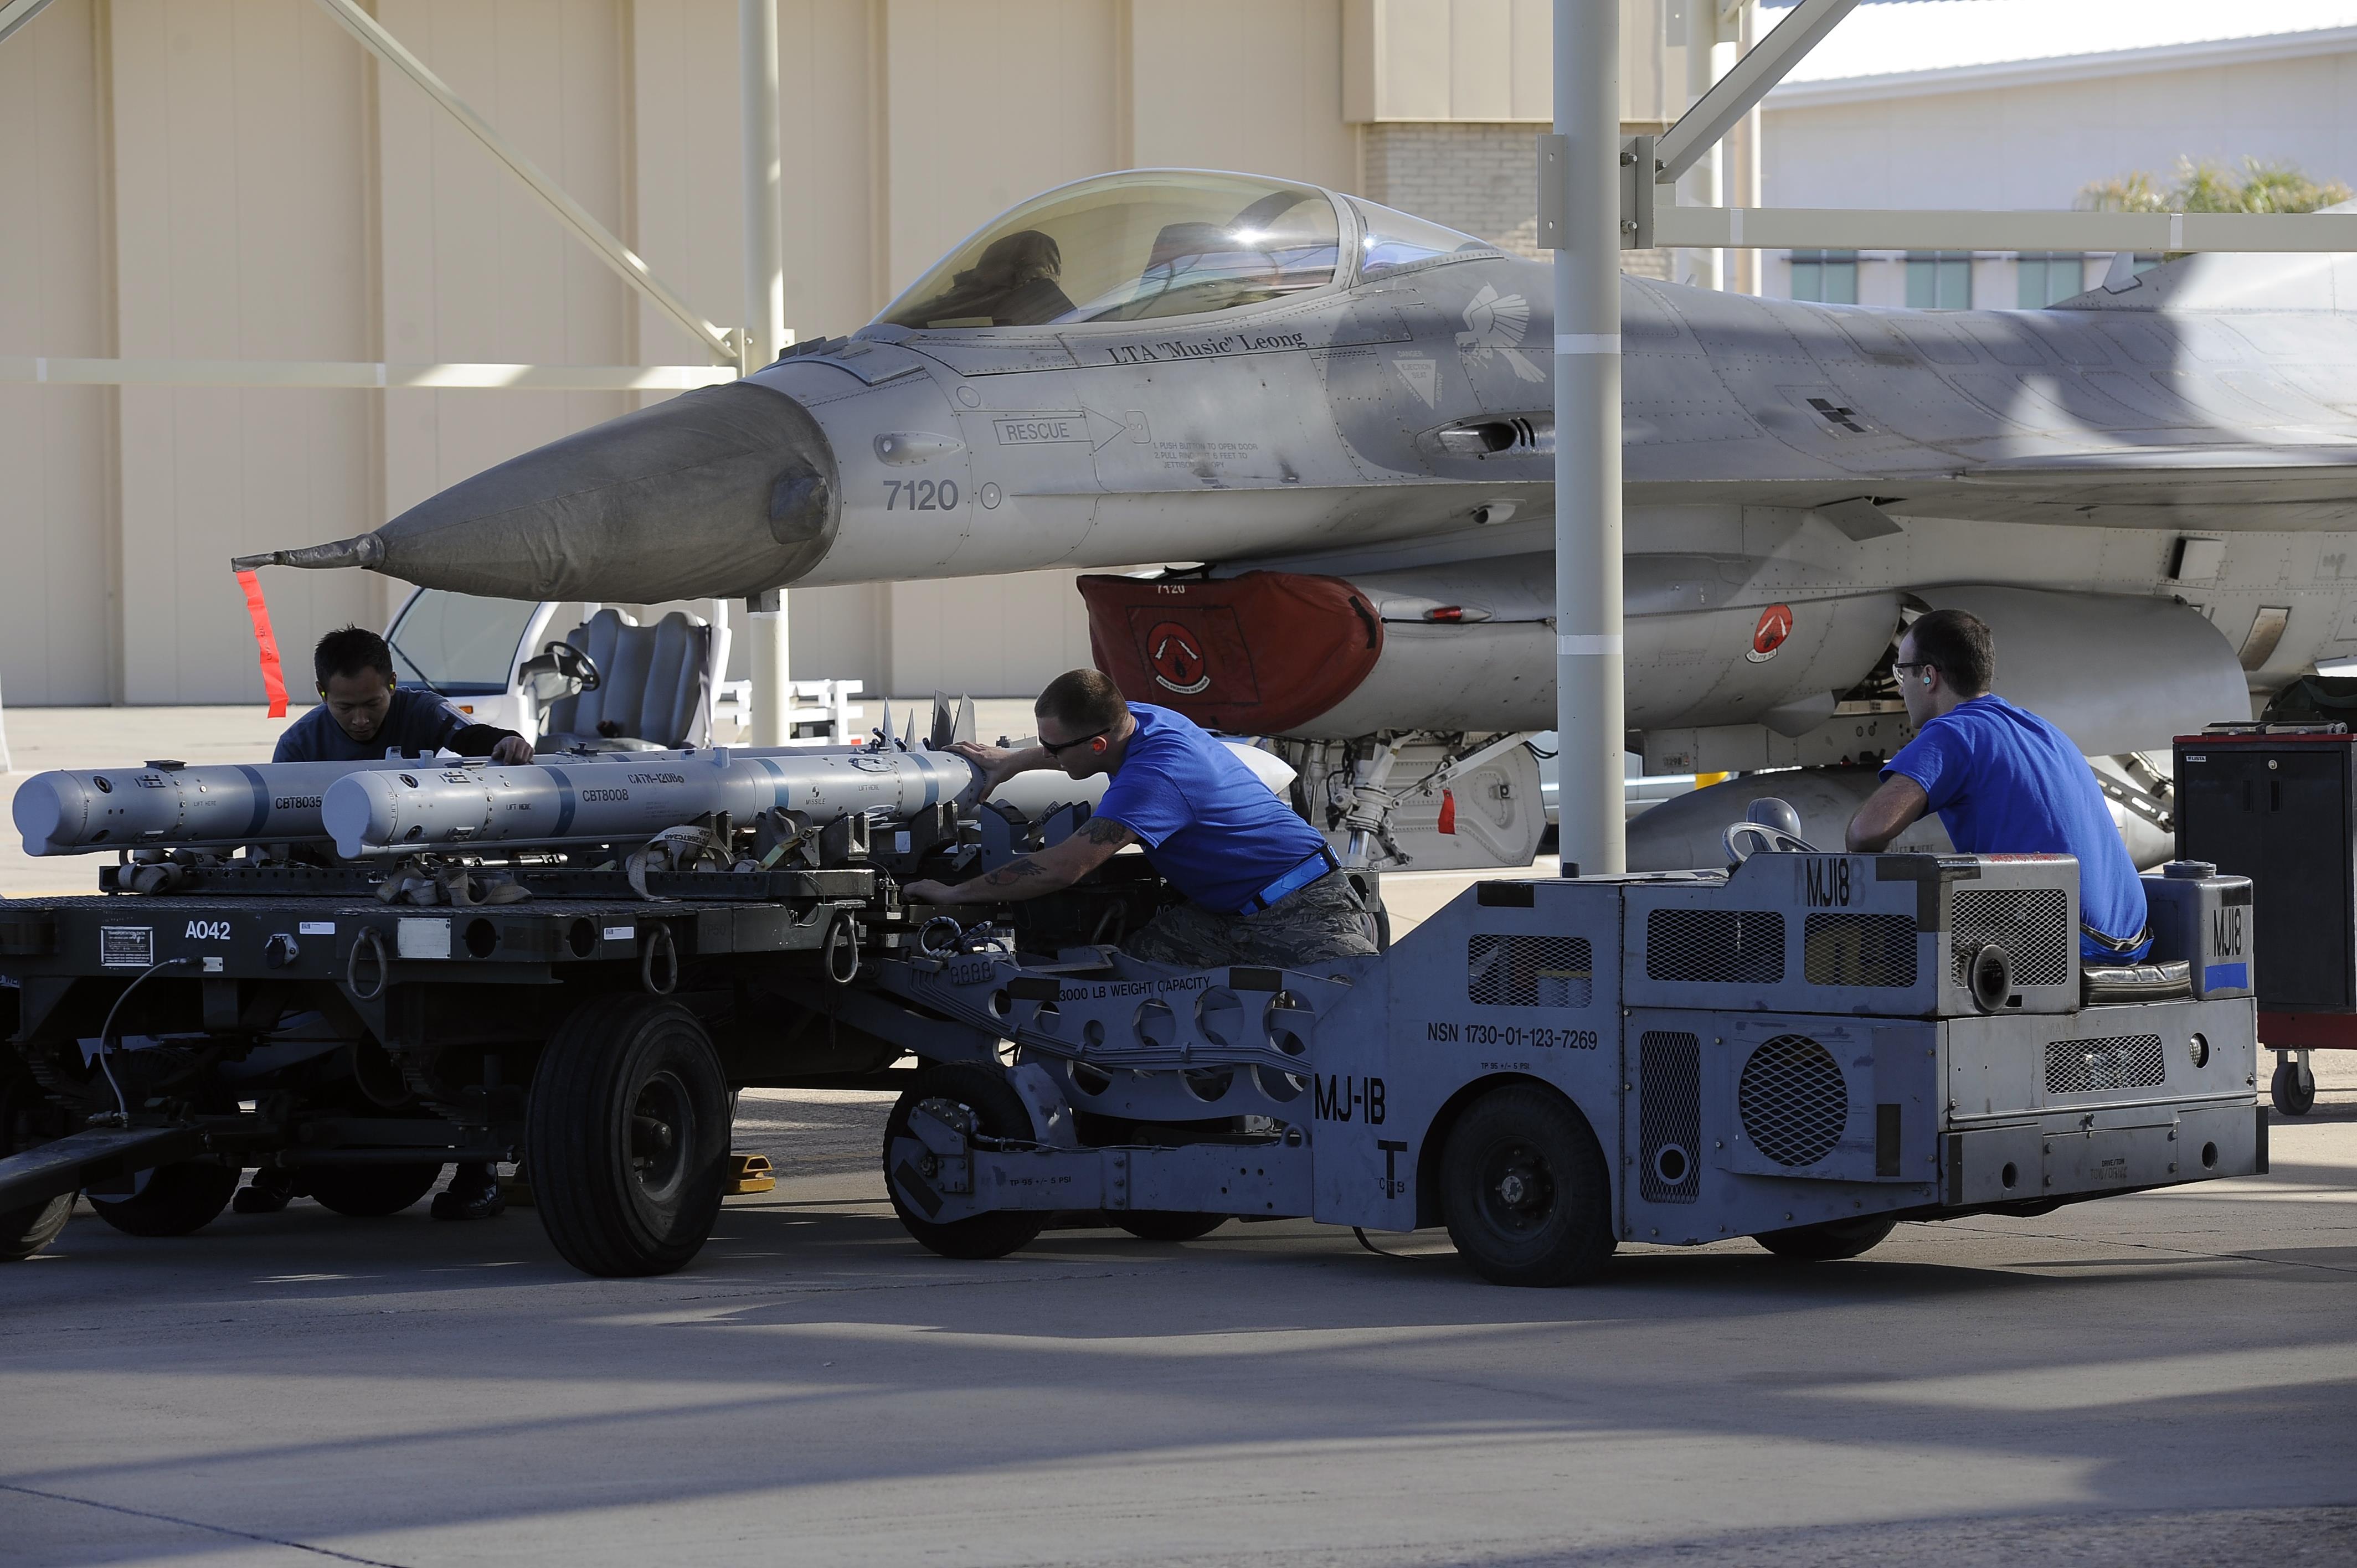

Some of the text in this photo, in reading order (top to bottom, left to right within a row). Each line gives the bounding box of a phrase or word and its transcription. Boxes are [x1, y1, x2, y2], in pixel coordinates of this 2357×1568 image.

[1105, 332, 1308, 363] LTA "Music" Leong
[1006, 422, 1070, 441] RESCUE
[883, 479, 959, 510] 7120
[275, 796, 322, 810] CBT8035
[582, 788, 629, 802] CBT8008
[184, 920, 231, 940] A042
[1059, 976, 1211, 1002] 3000 LB WEIGHT CAPACITY
[1427, 1022, 1598, 1050] NSN 1730-01-123-7269
[1058, 1175, 1072, 1184] PSI
[1377, 1139, 1408, 1199] T
